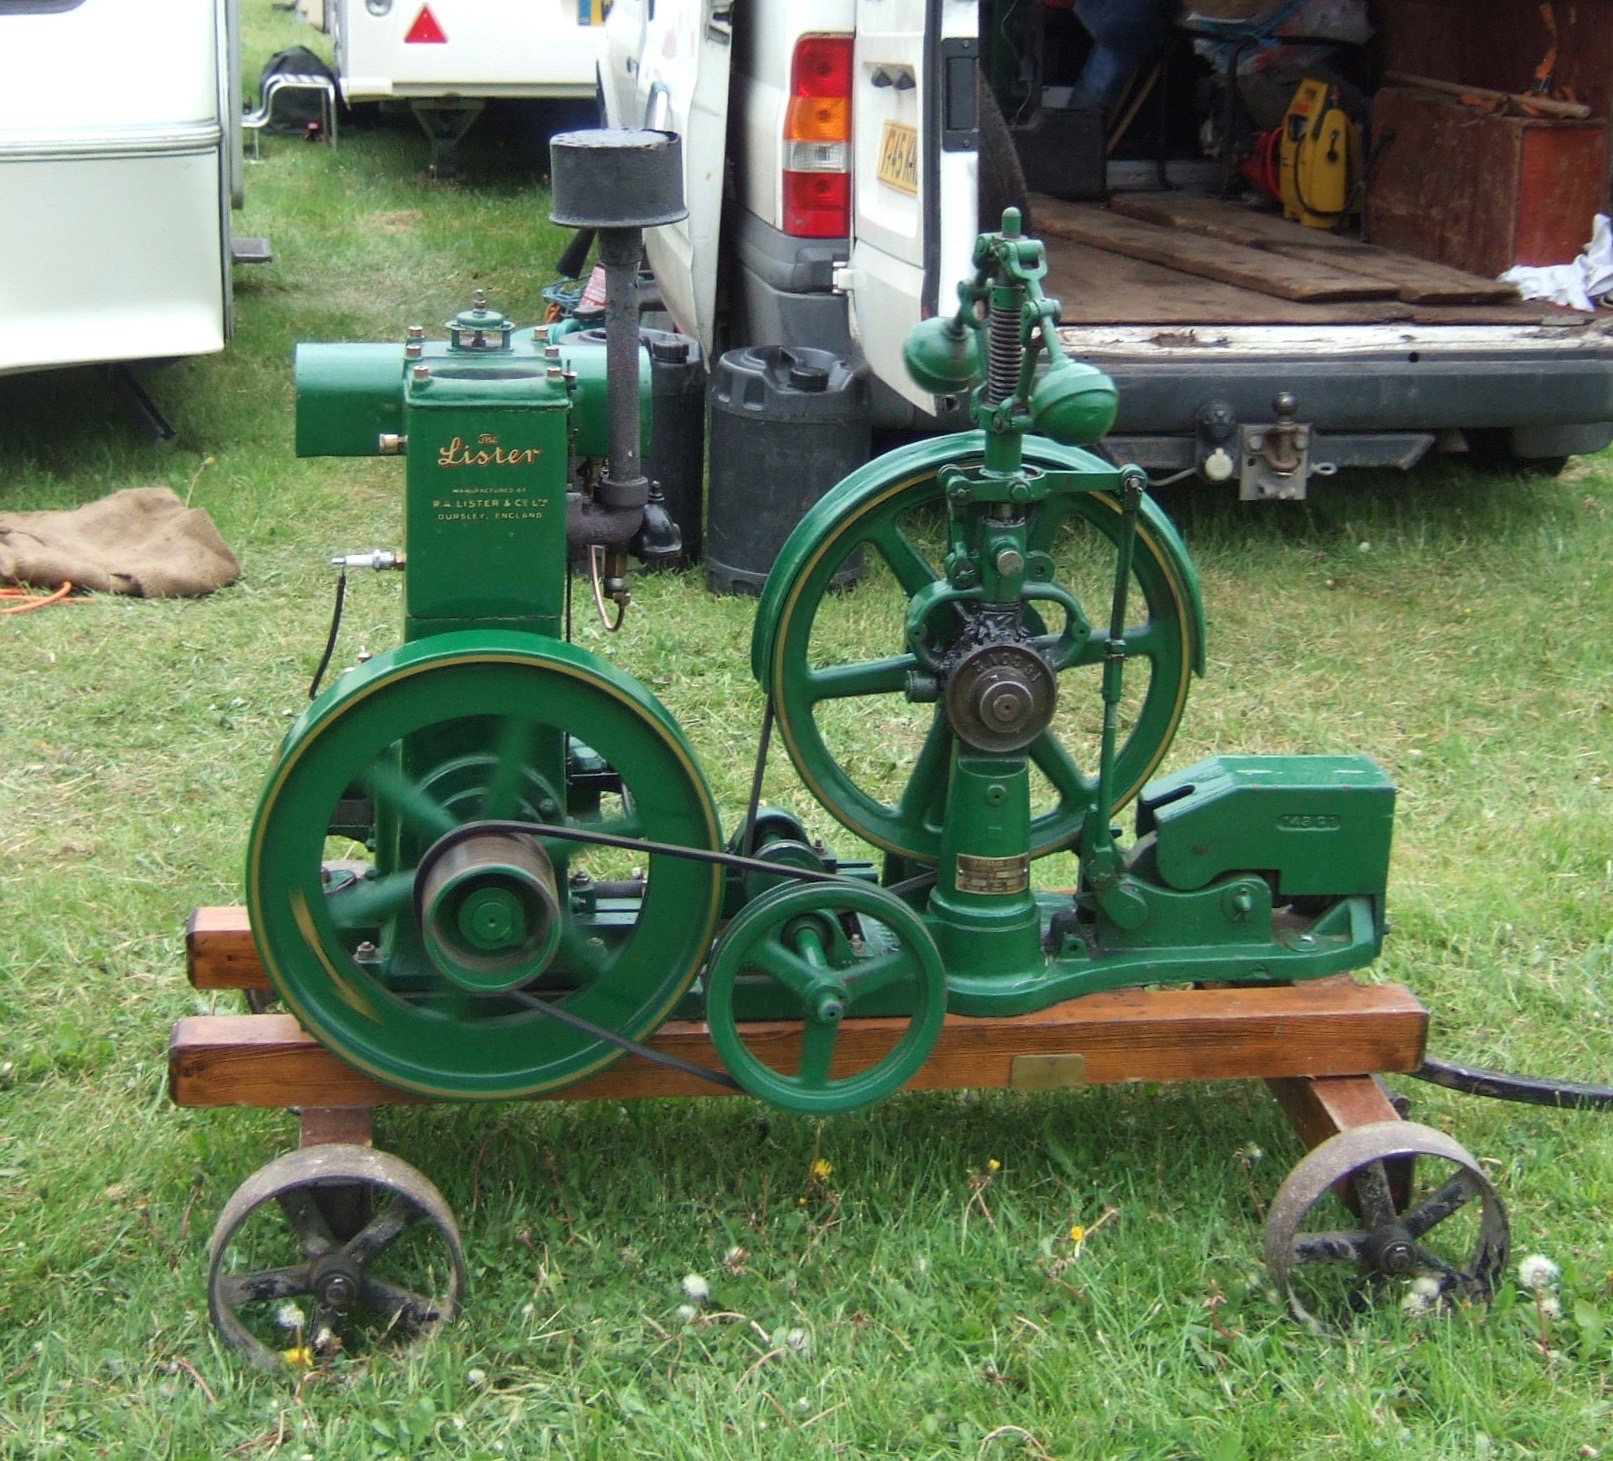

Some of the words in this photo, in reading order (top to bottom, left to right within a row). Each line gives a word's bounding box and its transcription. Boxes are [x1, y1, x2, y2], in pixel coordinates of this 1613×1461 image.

[478, 433, 498, 444] The
[437, 437, 544, 469] Lister
[452, 487, 514, 495] MANUFACTURED
[456, 500, 499, 508] LISTER
[504, 499, 511, 507] &
[495, 512, 543, 520] ENGLAND
